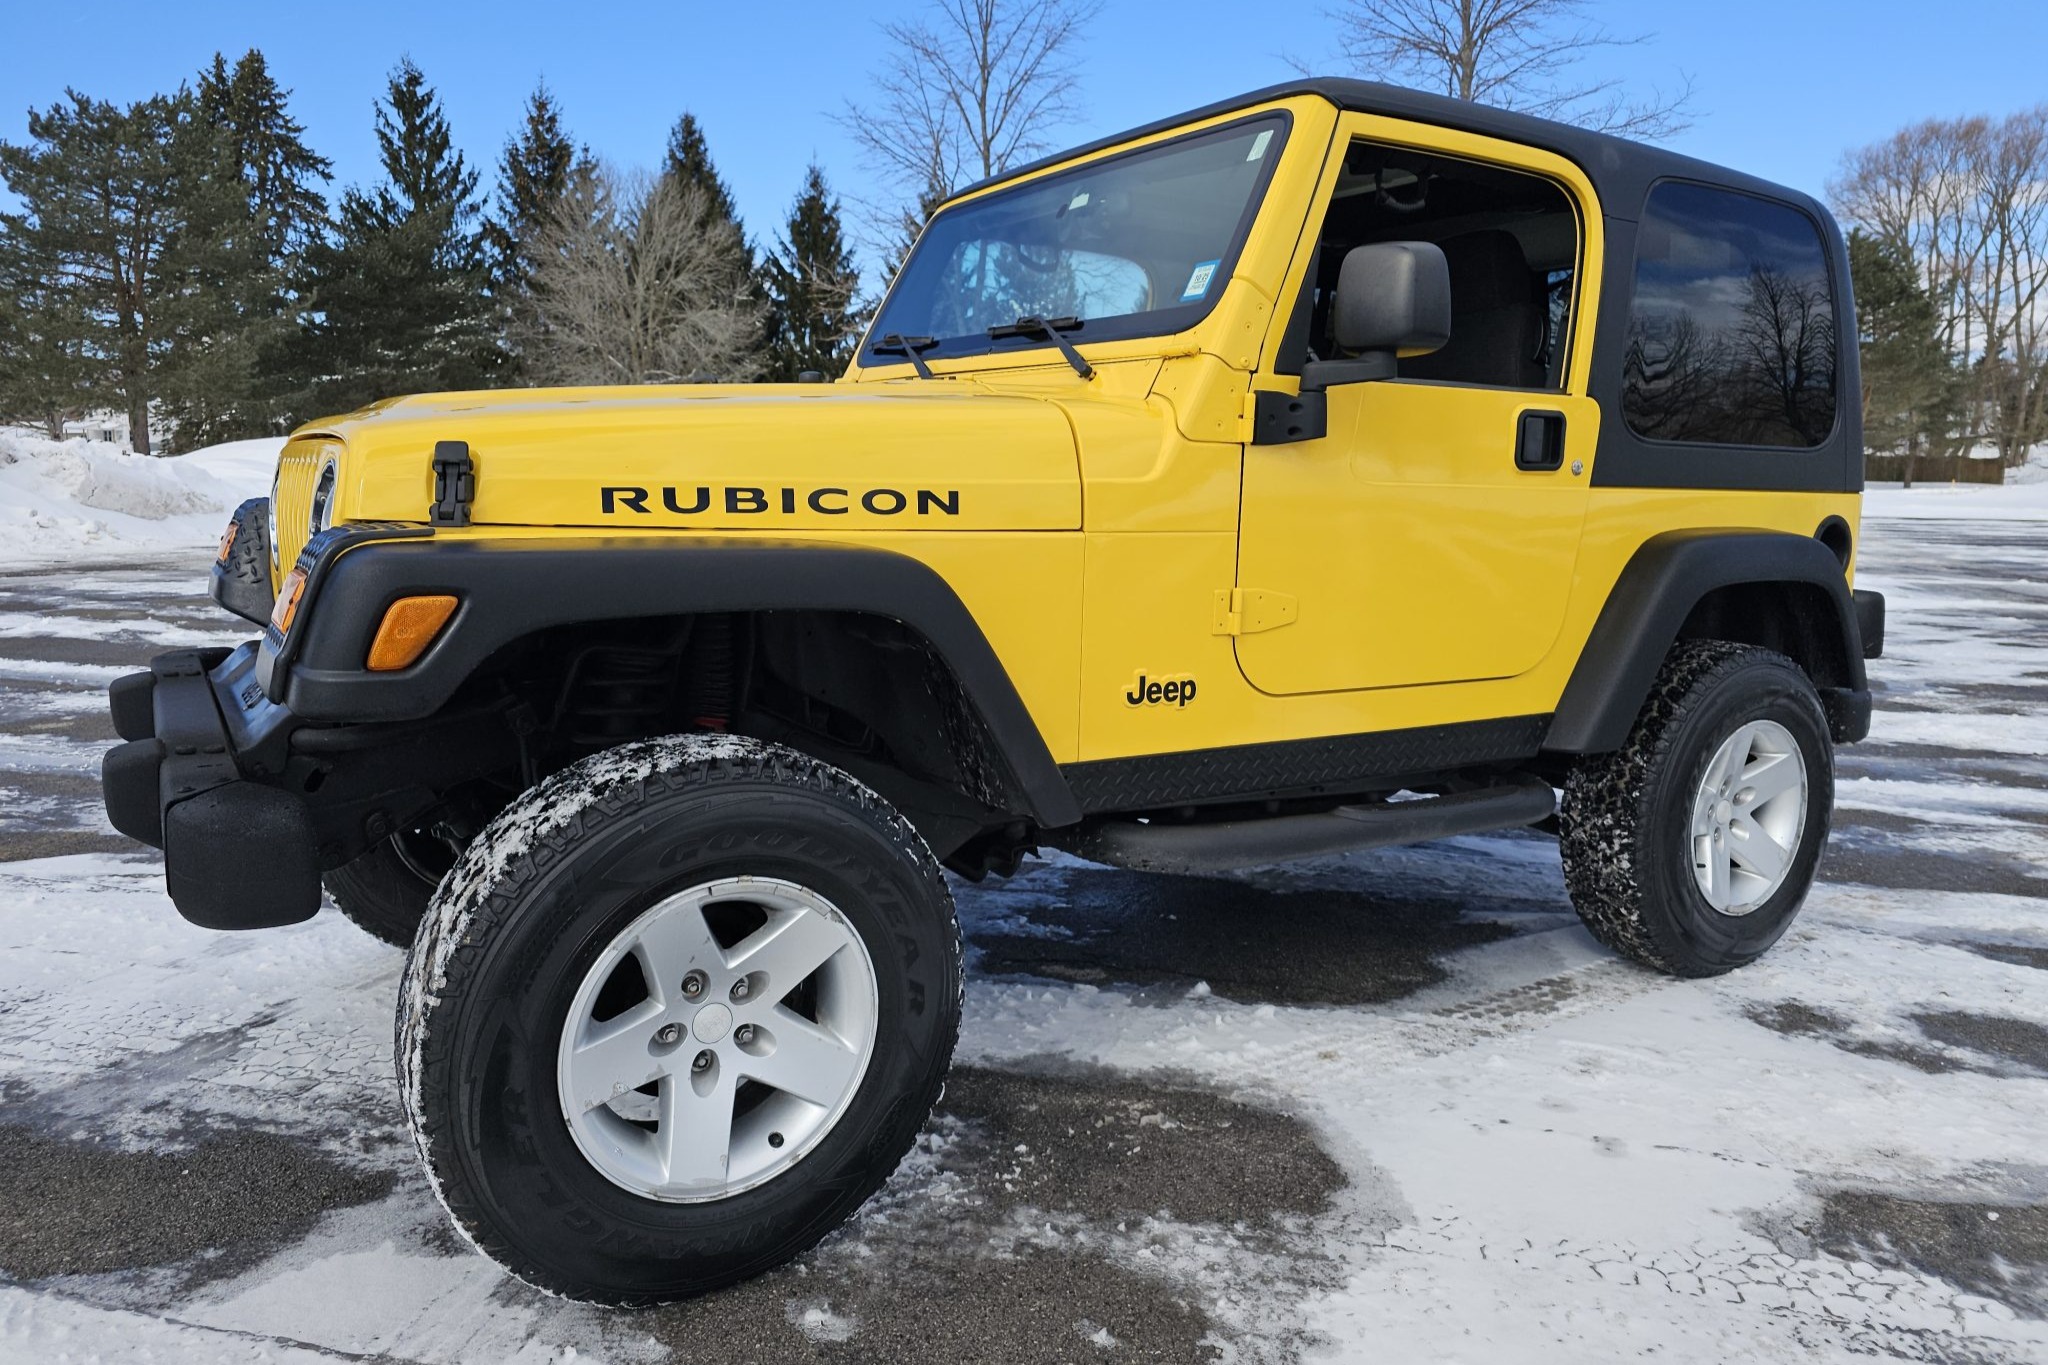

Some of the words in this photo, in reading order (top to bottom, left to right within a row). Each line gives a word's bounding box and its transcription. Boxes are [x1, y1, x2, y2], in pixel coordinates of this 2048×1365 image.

[600, 486, 960, 515] RUBICON
[1126, 675, 1197, 707] Jeep
[655, 828, 926, 1018] GOODYEAR
